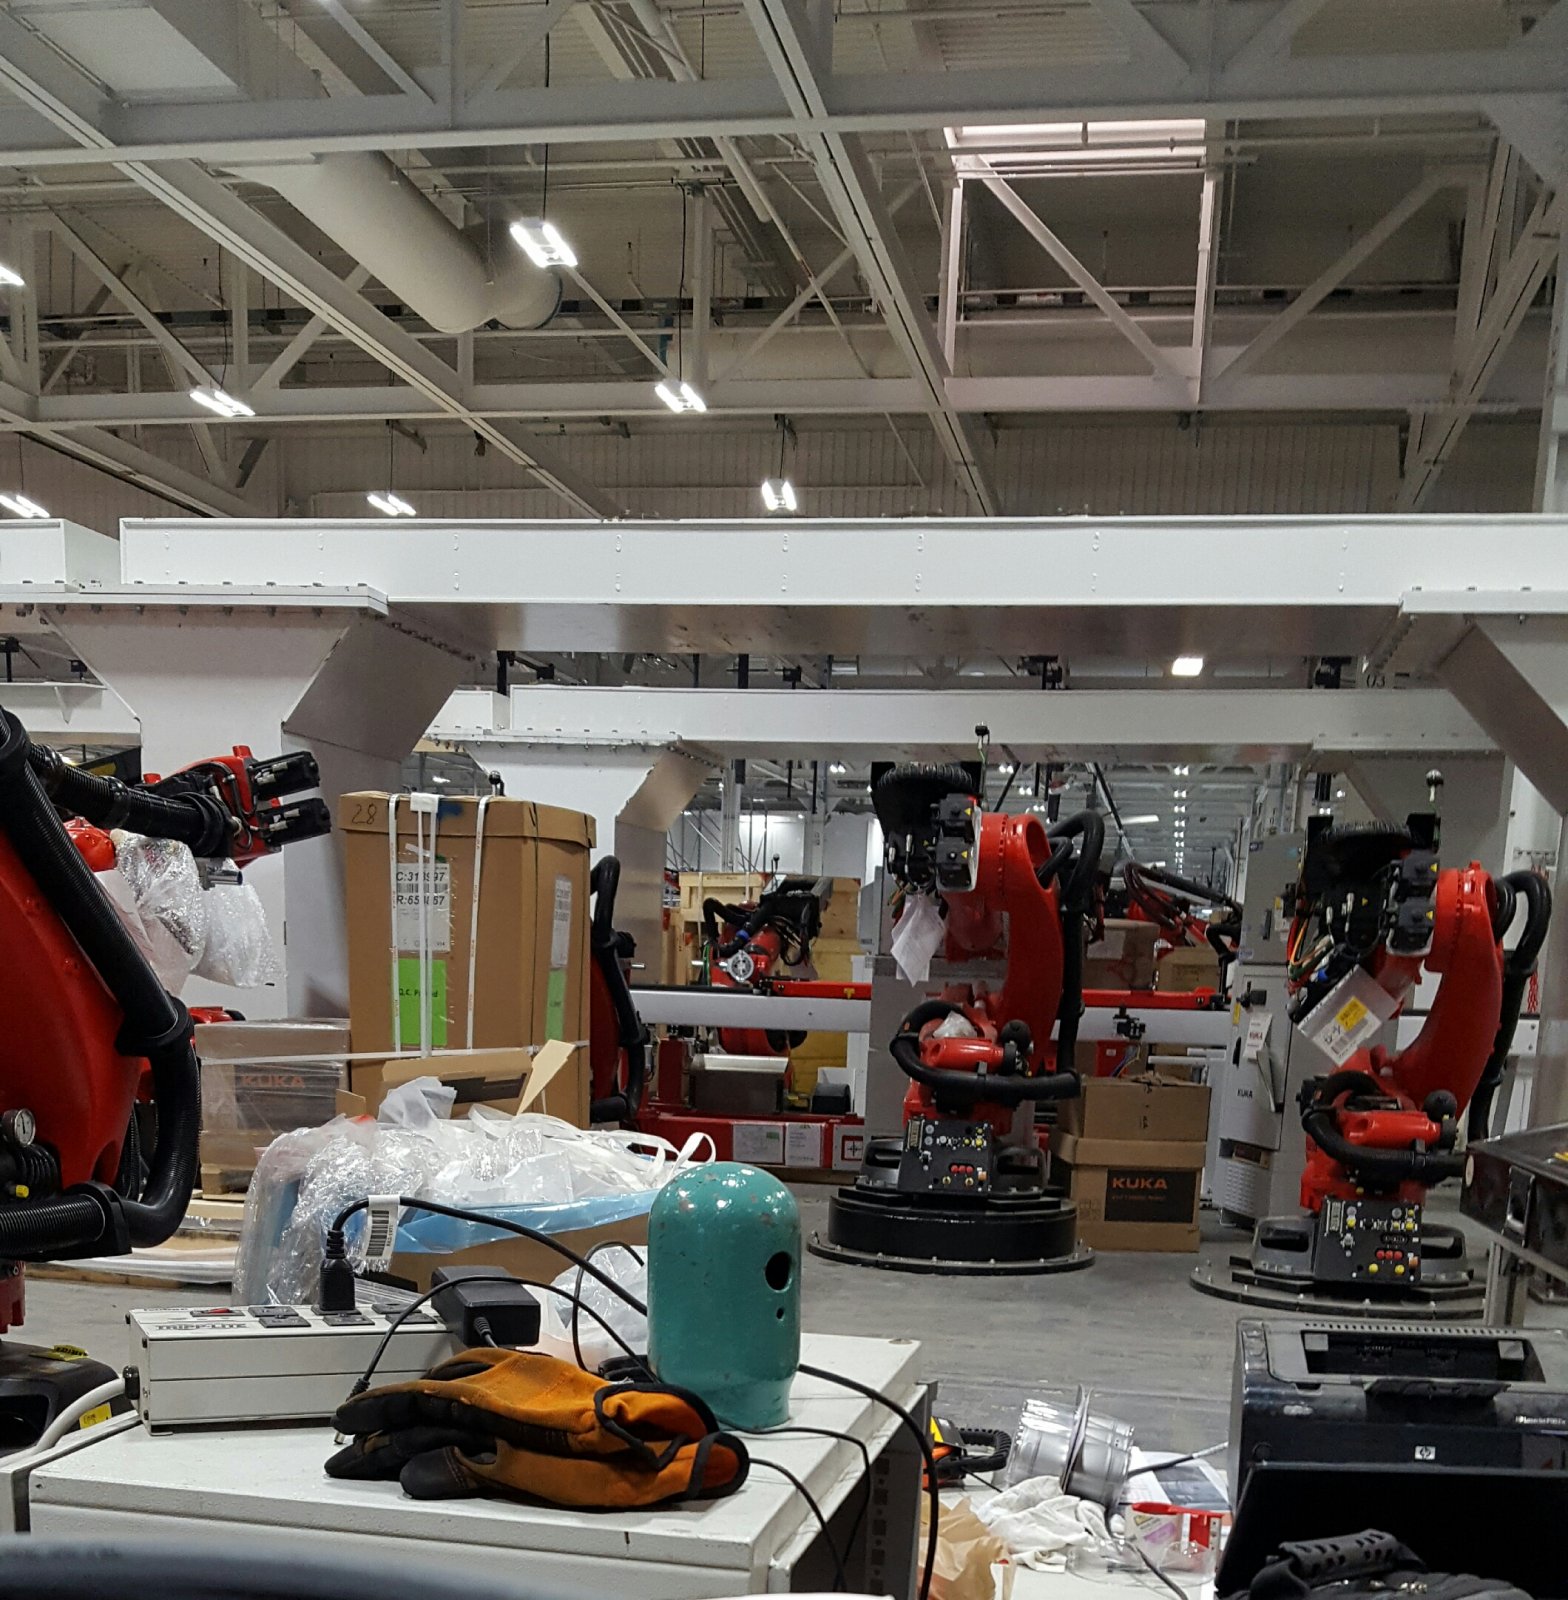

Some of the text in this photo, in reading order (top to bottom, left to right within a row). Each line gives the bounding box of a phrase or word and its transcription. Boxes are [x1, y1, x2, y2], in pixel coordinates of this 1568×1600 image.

[351, 803, 377, 825] 28
[396, 895, 446, 906] R:6567
[241, 1075, 305, 1088] KUKA
[1112, 1177, 1168, 1190] KUKA
